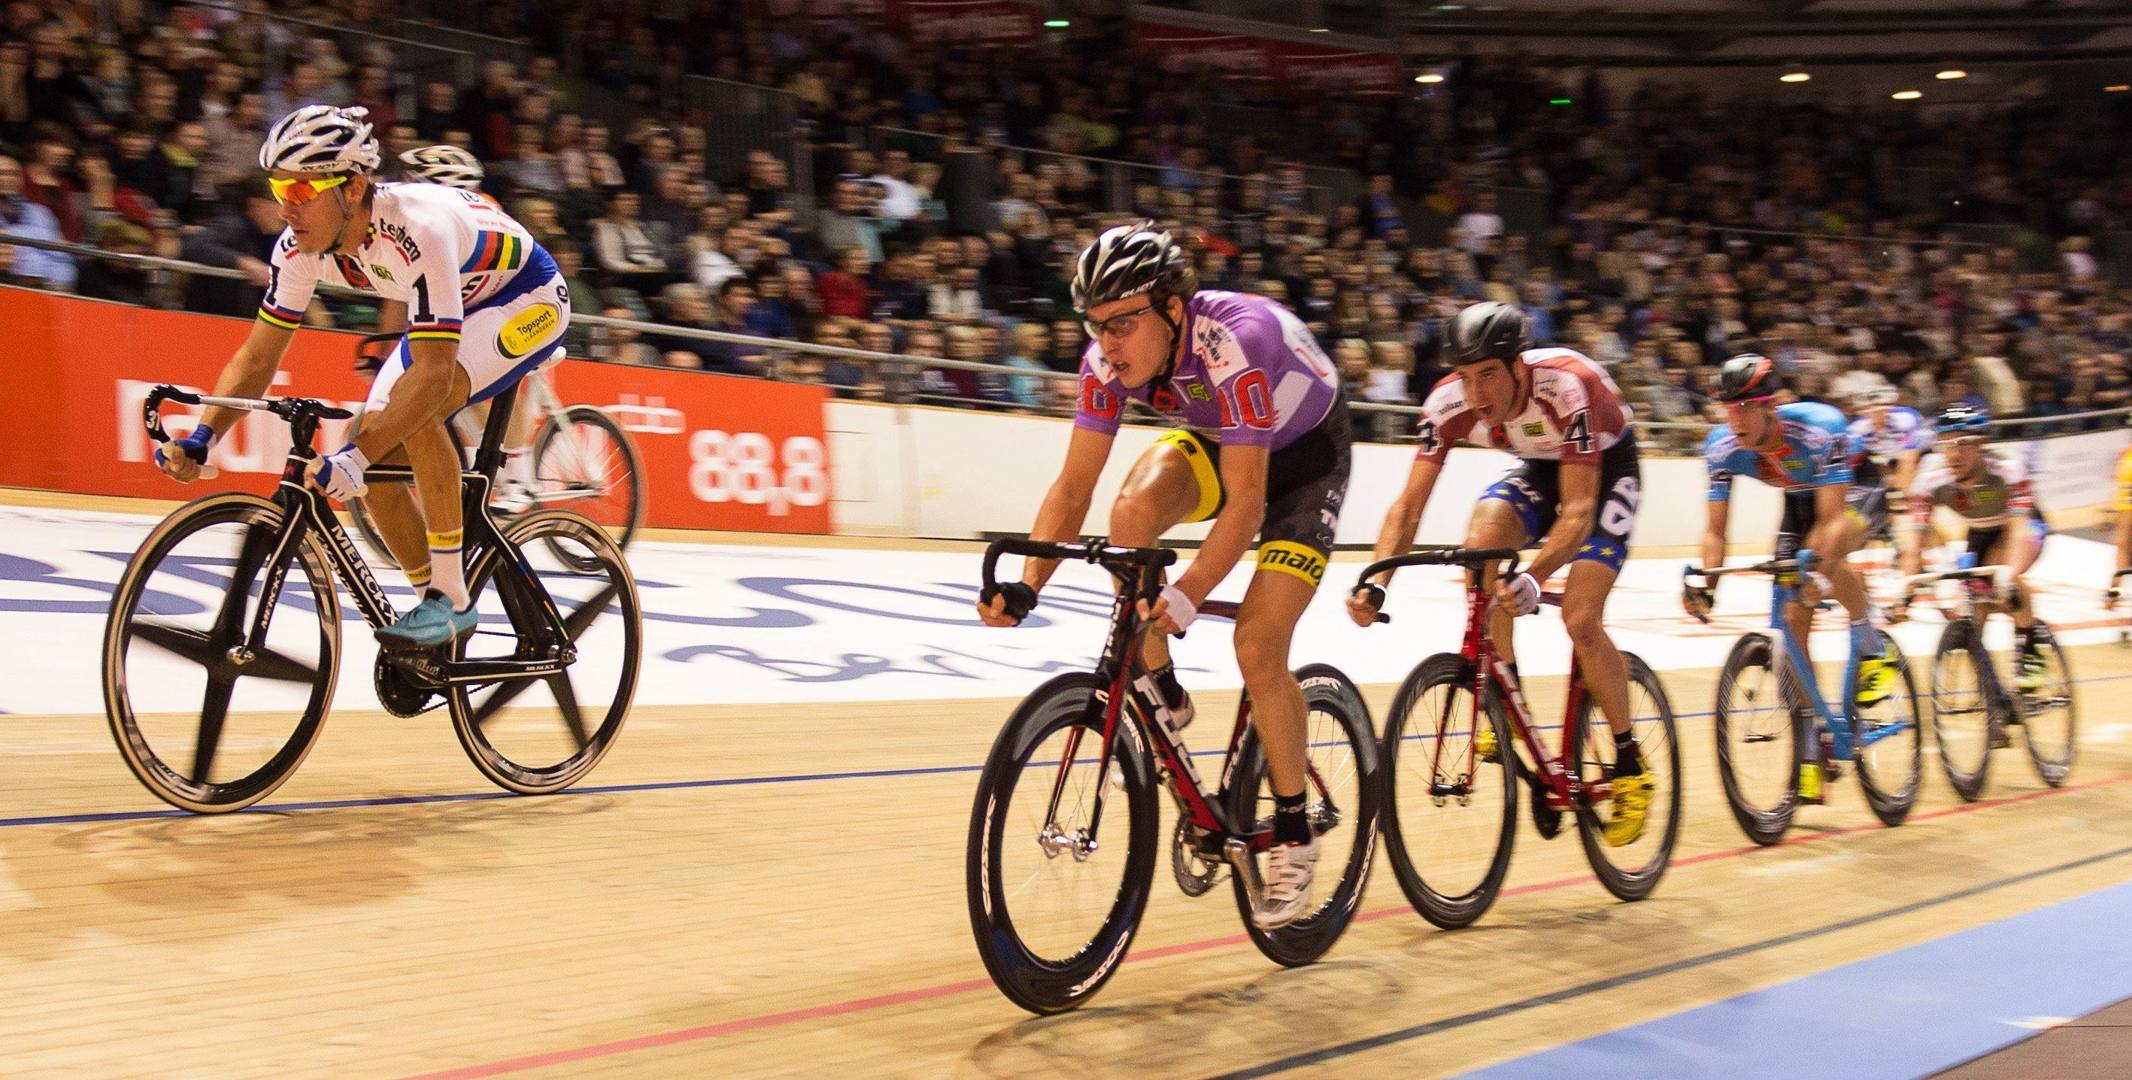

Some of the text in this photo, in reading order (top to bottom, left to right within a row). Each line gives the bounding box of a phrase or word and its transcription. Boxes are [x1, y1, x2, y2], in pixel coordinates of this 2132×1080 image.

[412, 273, 435, 322] 1
[517, 310, 552, 336] Topsport
[1216, 368, 1278, 430] 10
[1562, 409, 1593, 454] 4
[689, 428, 828, 517] 88,8
[260, 565, 283, 630] MERCKX
[331, 525, 399, 626] MERCKX
